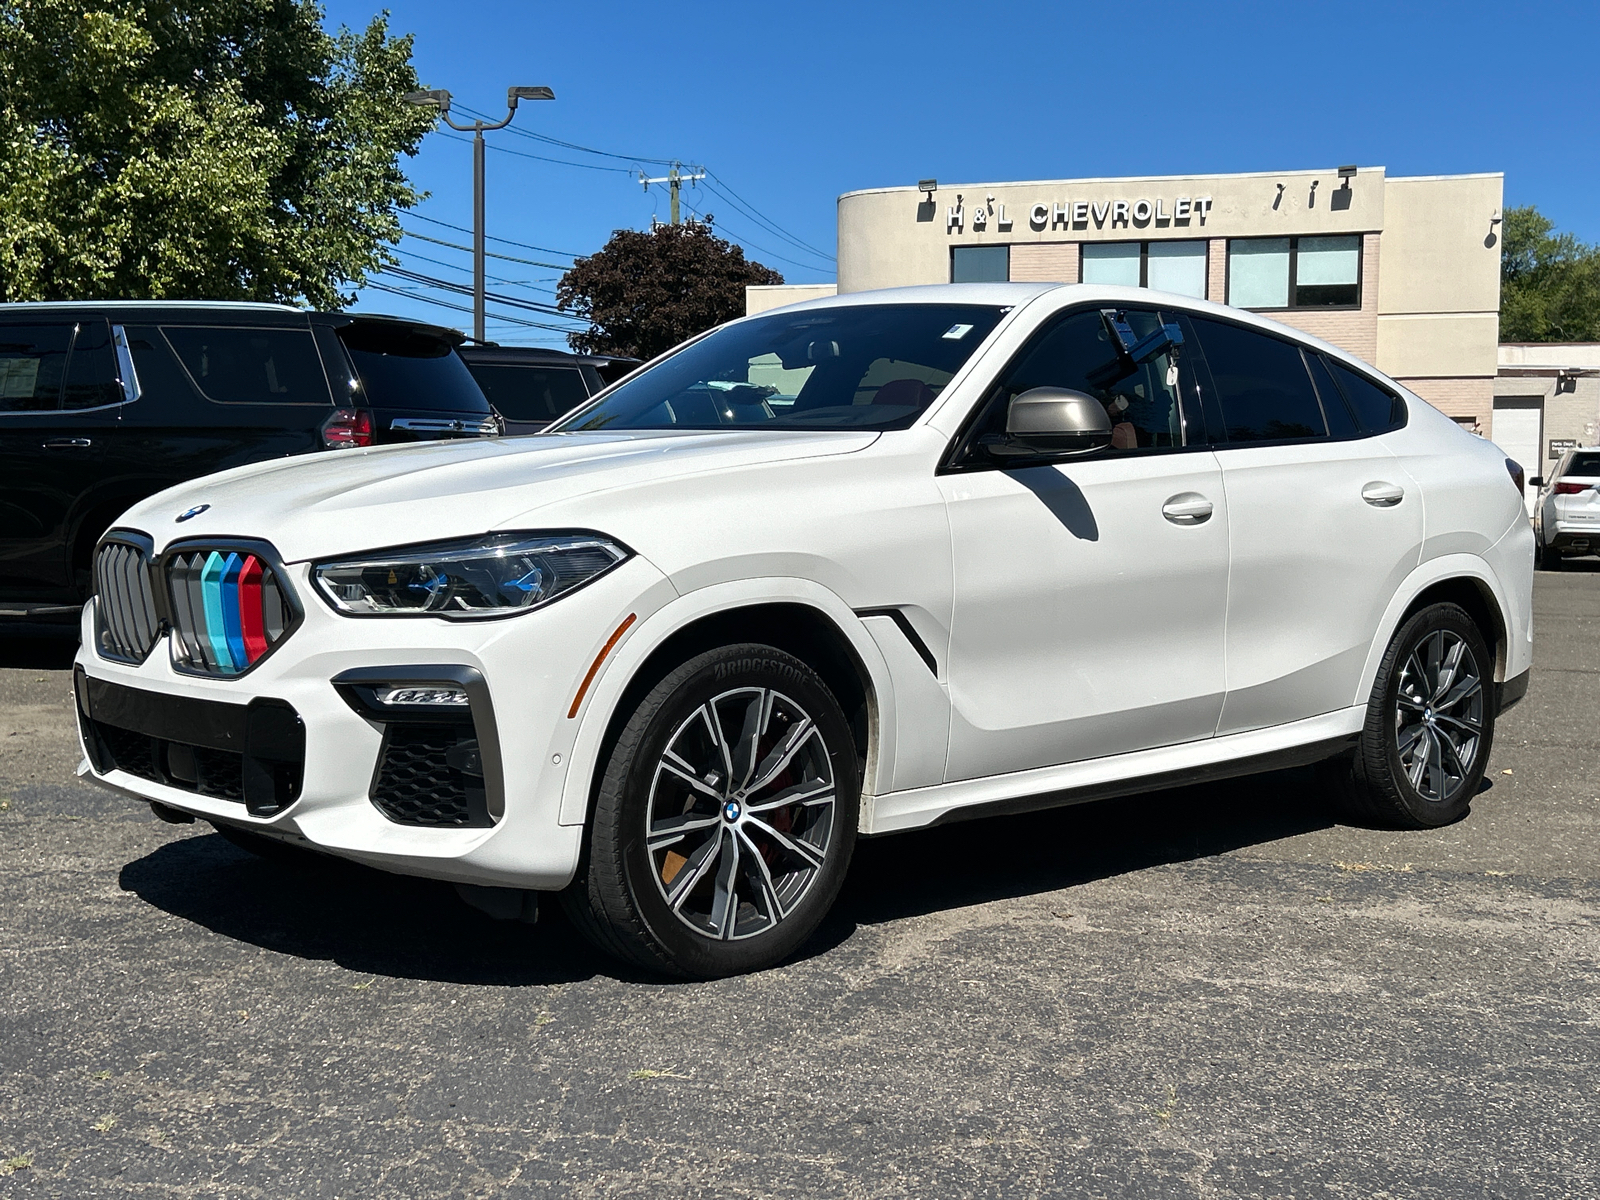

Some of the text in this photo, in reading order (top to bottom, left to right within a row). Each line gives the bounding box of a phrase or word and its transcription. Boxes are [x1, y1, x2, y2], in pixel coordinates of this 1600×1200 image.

[946, 196, 1213, 227] H & L CHEVROLET
[713, 657, 811, 686] BRIDGESTONE
